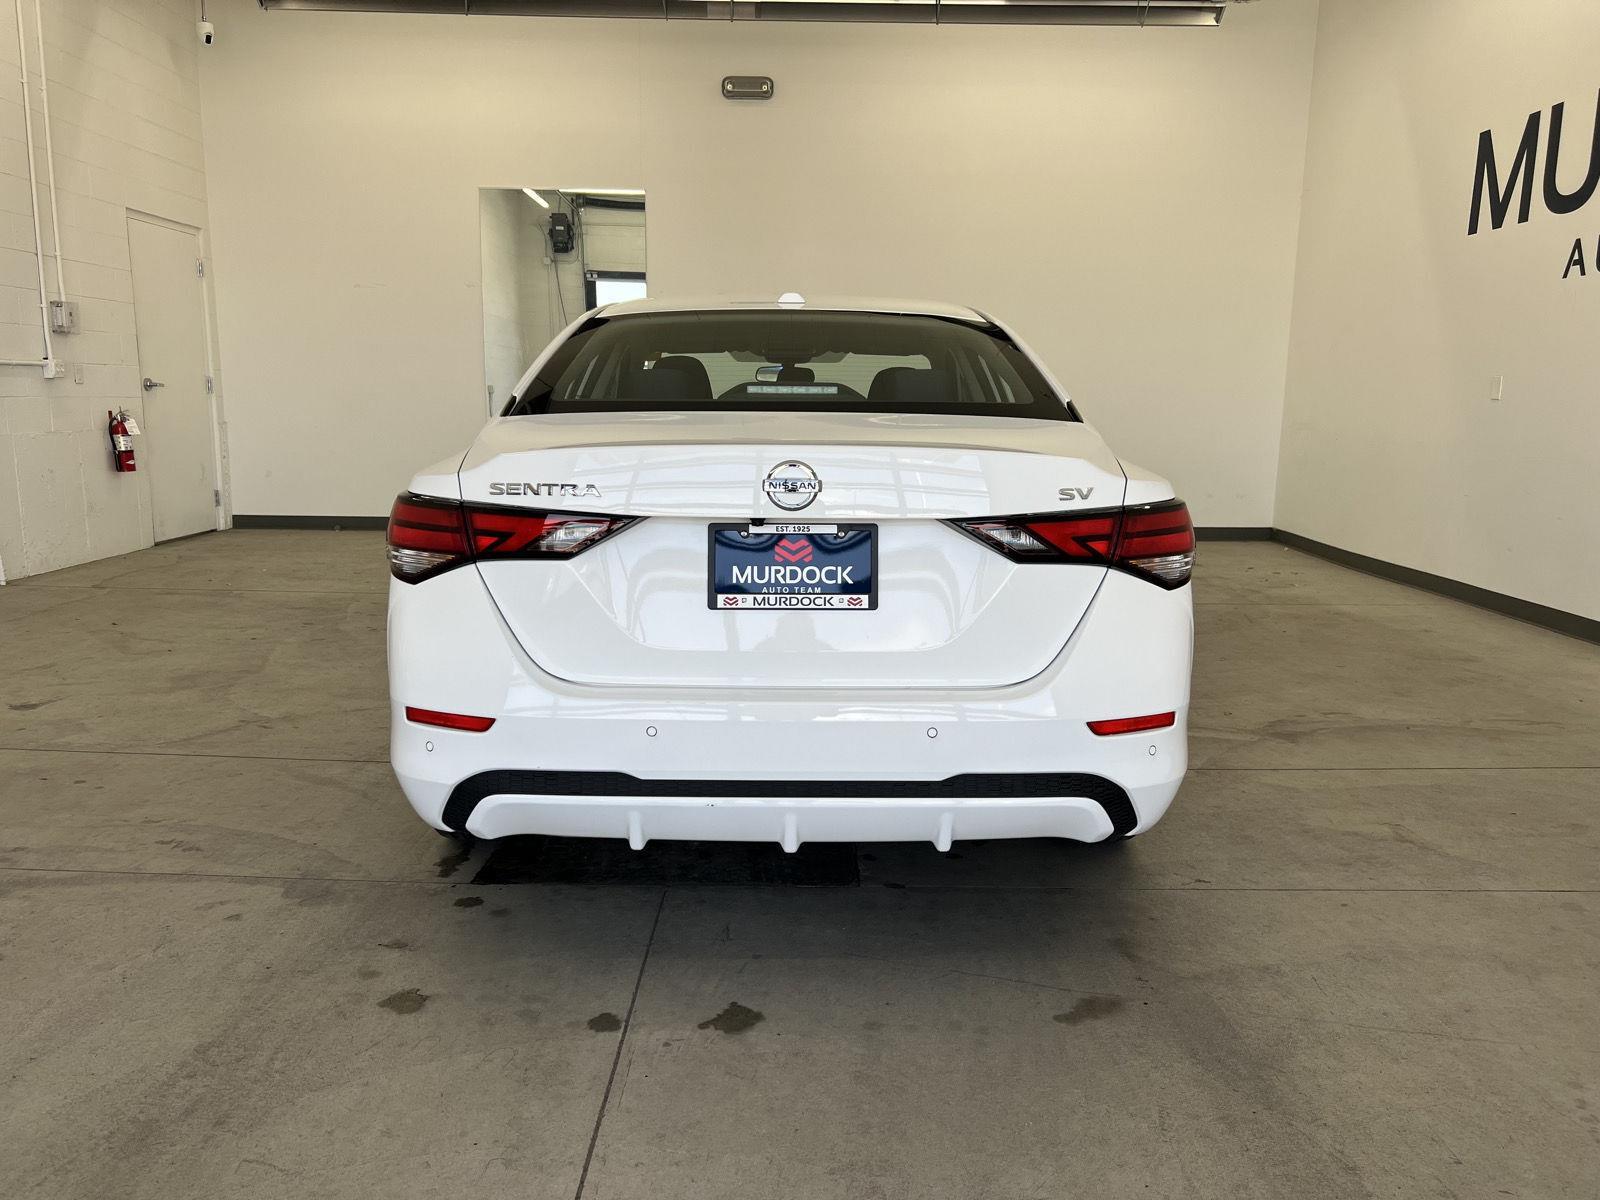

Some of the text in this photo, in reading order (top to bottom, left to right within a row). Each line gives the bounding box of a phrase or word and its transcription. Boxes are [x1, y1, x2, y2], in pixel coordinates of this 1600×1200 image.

[1467, 88, 1600, 236] MU
[1561, 234, 1600, 280] A
[489, 482, 602, 498] SENTRA
[768, 481, 817, 491] NISSAN
[1058, 487, 1094, 501] SV
[775, 525, 811, 533] EST. 1925
[732, 565, 854, 585] MURDOCK
[762, 586, 822, 594] AUTO TEAM
[752, 596, 835, 607] MURDOCK
